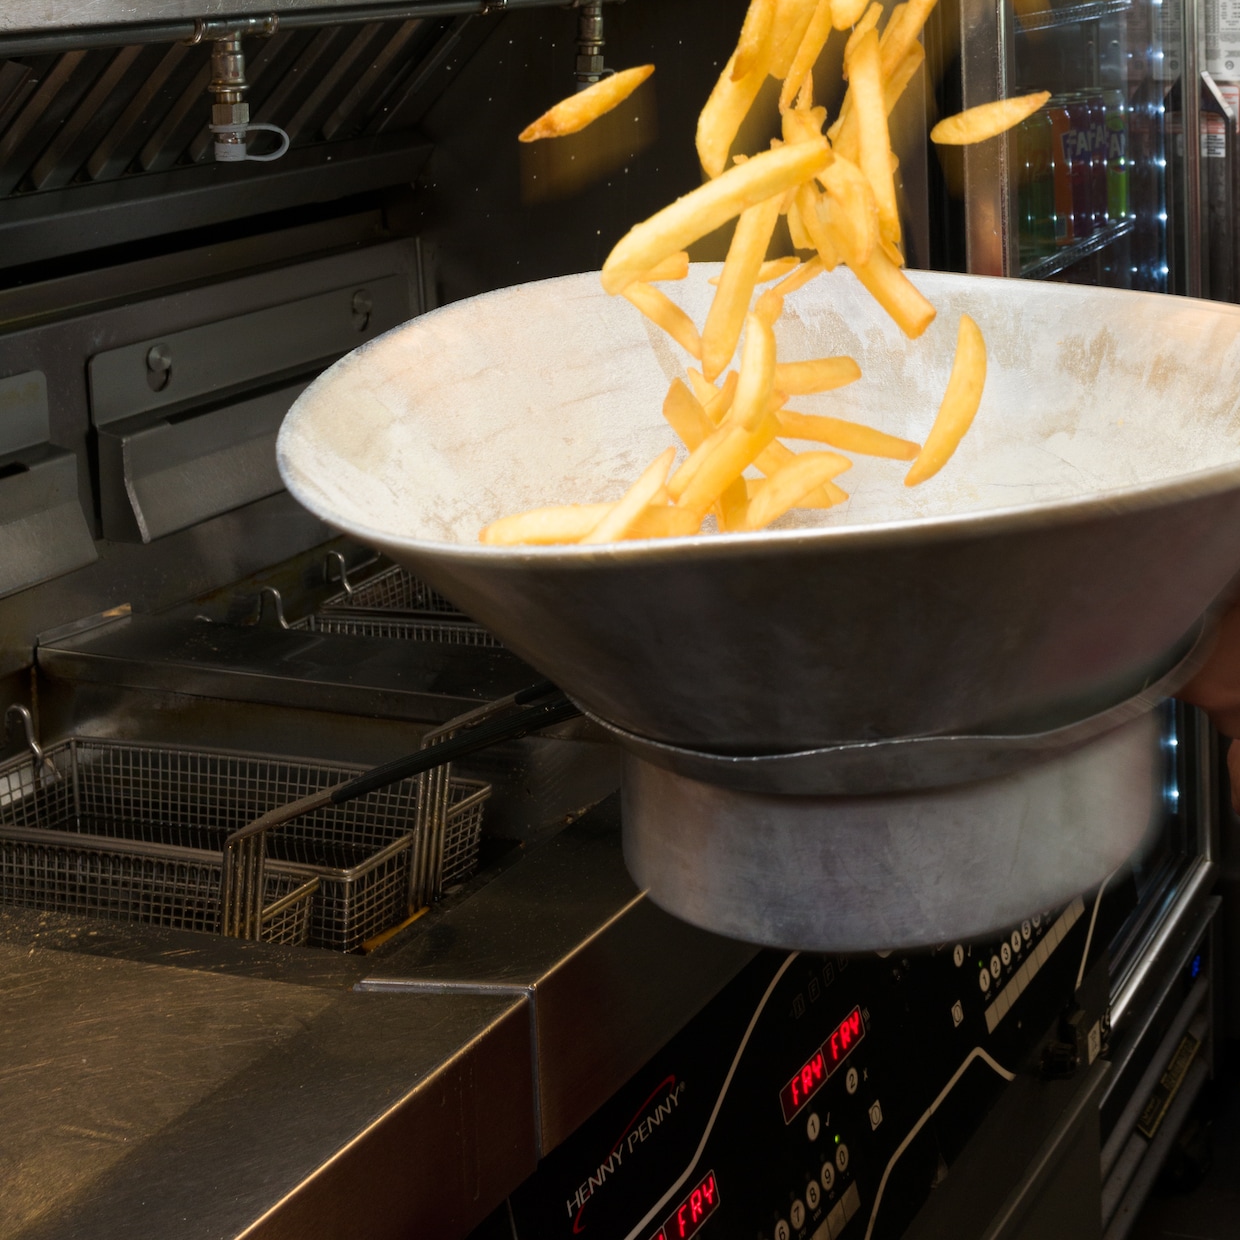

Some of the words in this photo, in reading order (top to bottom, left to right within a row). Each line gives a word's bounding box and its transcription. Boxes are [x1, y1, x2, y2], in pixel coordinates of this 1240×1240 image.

[790, 1053, 823, 1106] FRY
[829, 1010, 860, 1060] FRY
[566, 1143, 624, 1218] HENNY
[626, 1084, 682, 1154] PENNY
[677, 1175, 715, 1239] FRY
